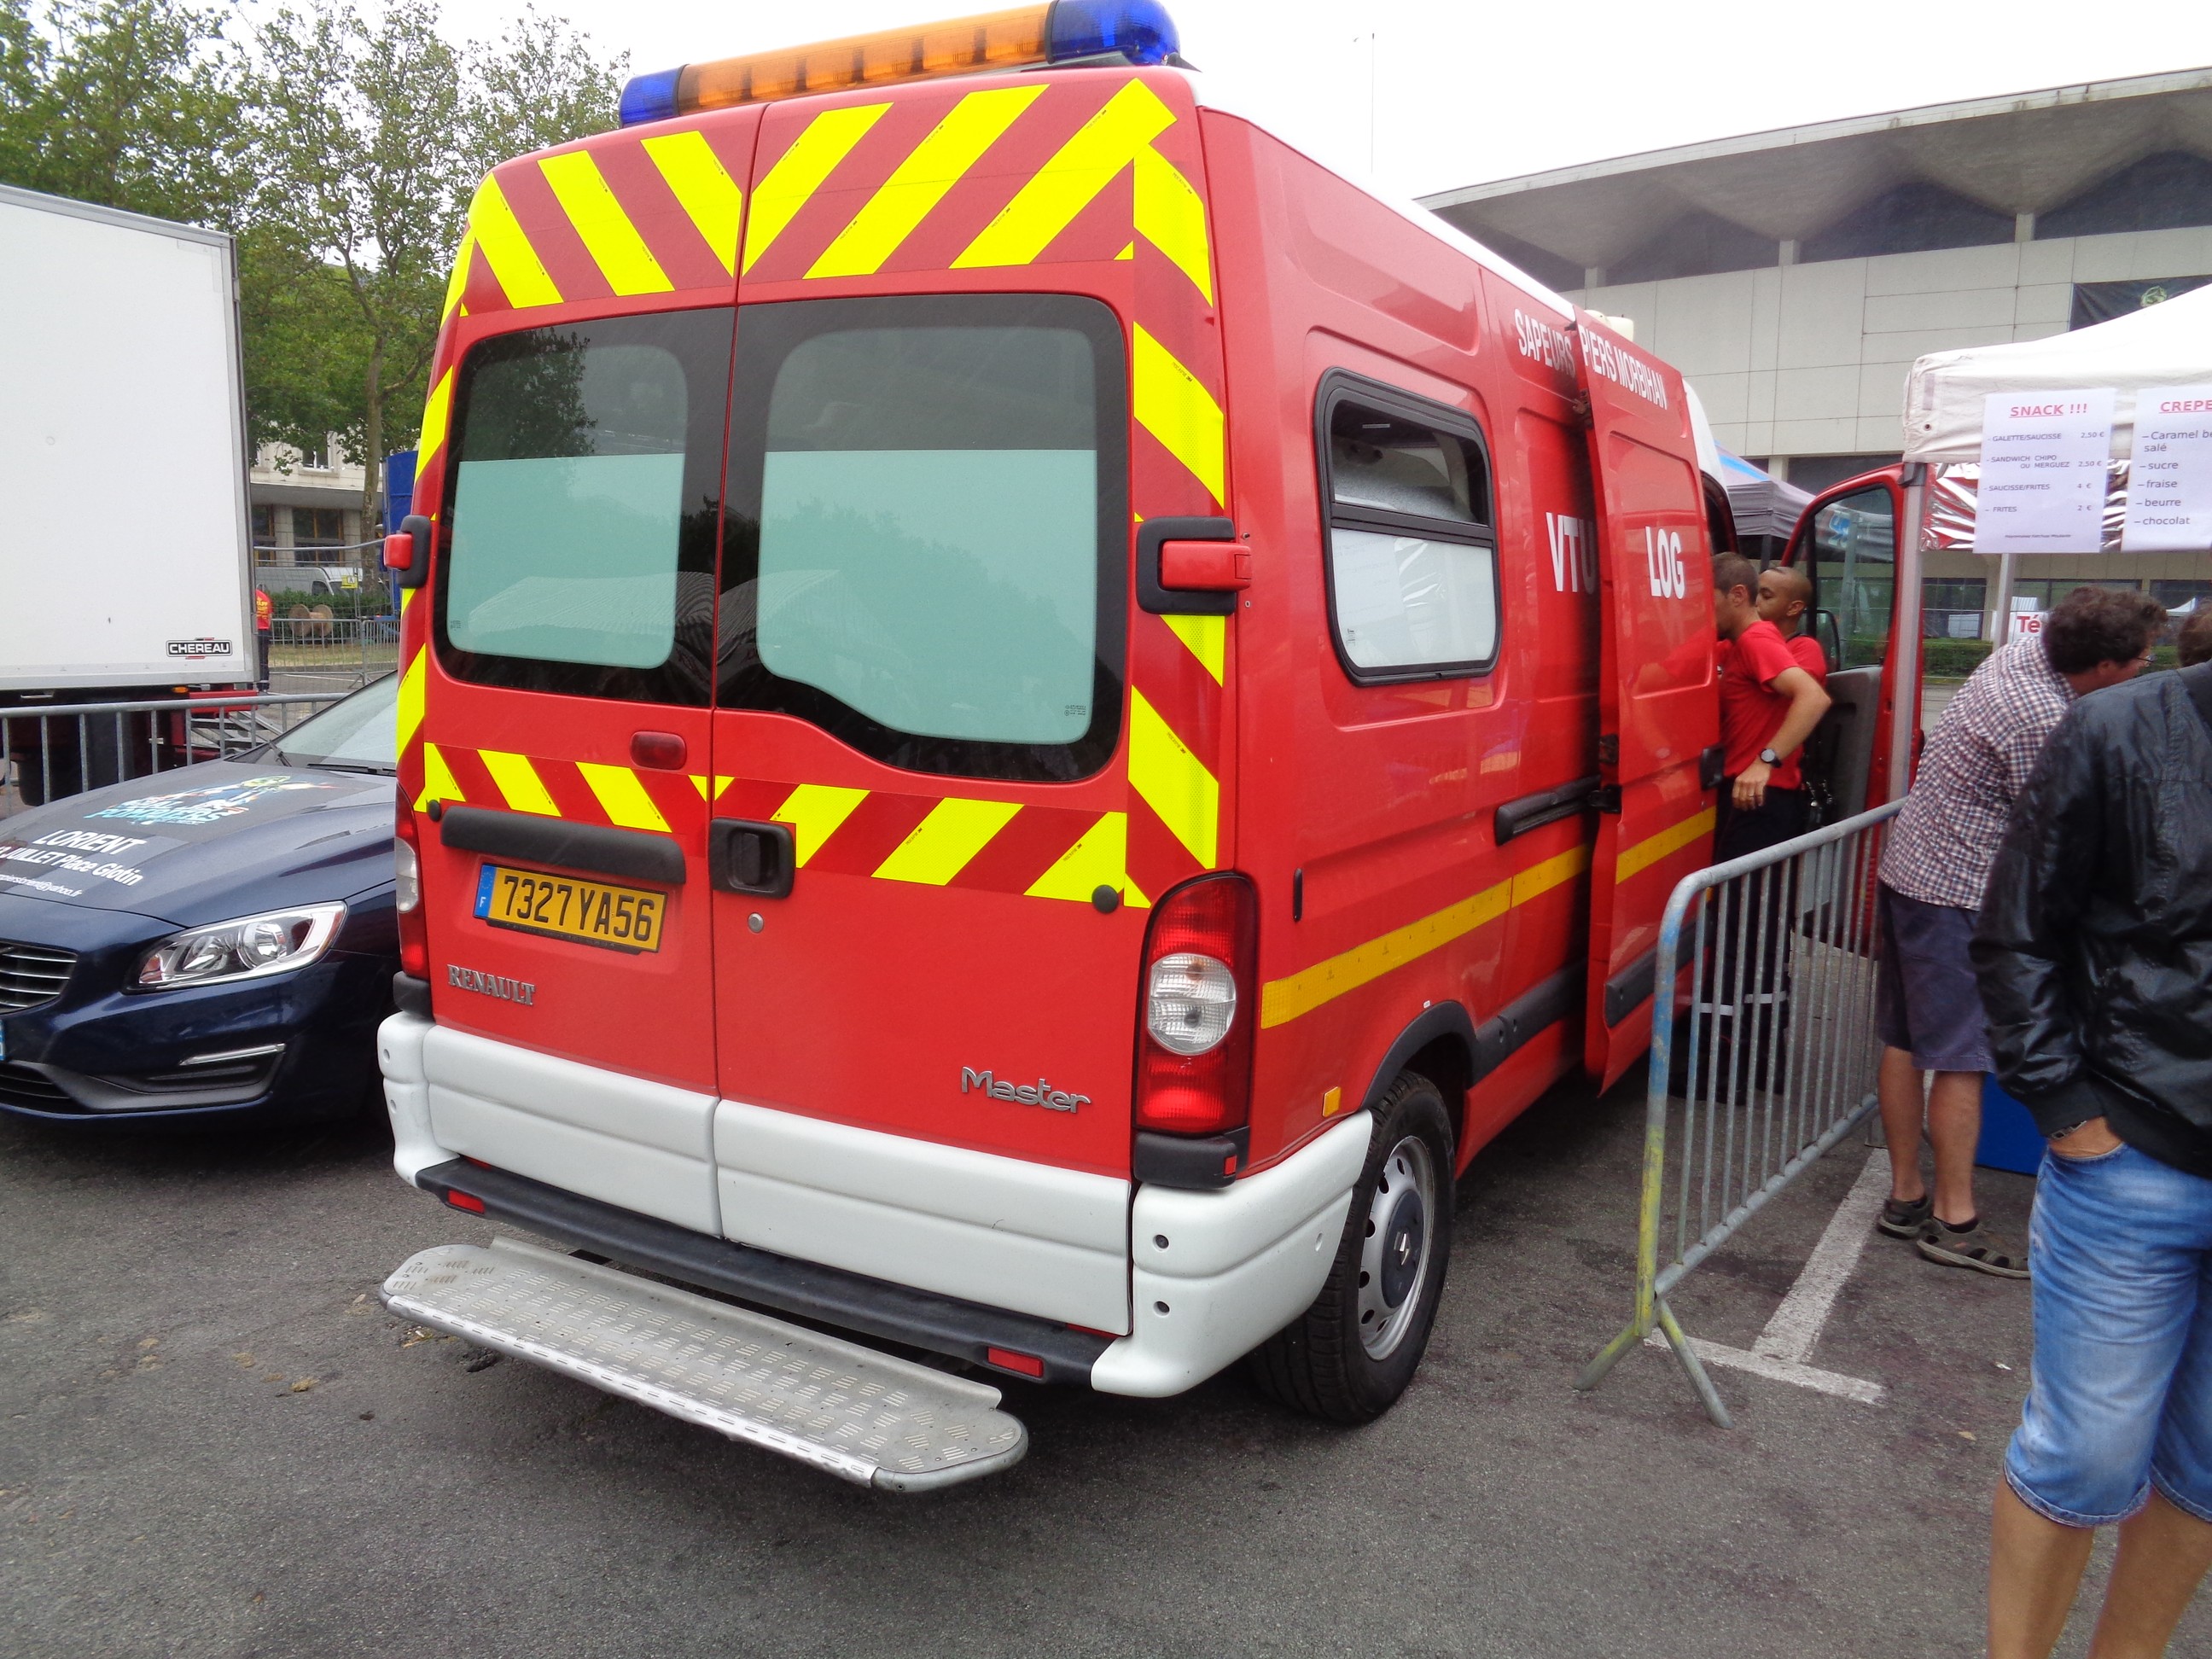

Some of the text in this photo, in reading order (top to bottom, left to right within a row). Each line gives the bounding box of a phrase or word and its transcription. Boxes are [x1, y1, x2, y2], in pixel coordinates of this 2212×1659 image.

[1514, 309, 1576, 378] SAPEURS
[1614, 346, 1668, 410] MORBIHAN
[2010, 404, 2087, 417] SNACK !!!
[2151, 430, 2199, 440] Caramel
[2144, 443, 2167, 452] salé
[2148, 462, 2179, 470] sucre
[2146, 480, 2178, 488] fraise
[2145, 498, 2181, 507] beurre
[2143, 516, 2191, 525] chocolat
[1645, 526, 1685, 599] LOG
[170, 643, 230, 654] CHEREAU
[32, 830, 148, 854] LORIENT
[51, 853, 98, 872] Place
[92, 863, 143, 886] Glotin
[479, 896, 486, 907] F
[447, 963, 536, 1005] RENAULT
[961, 1066, 1091, 1113] Master
